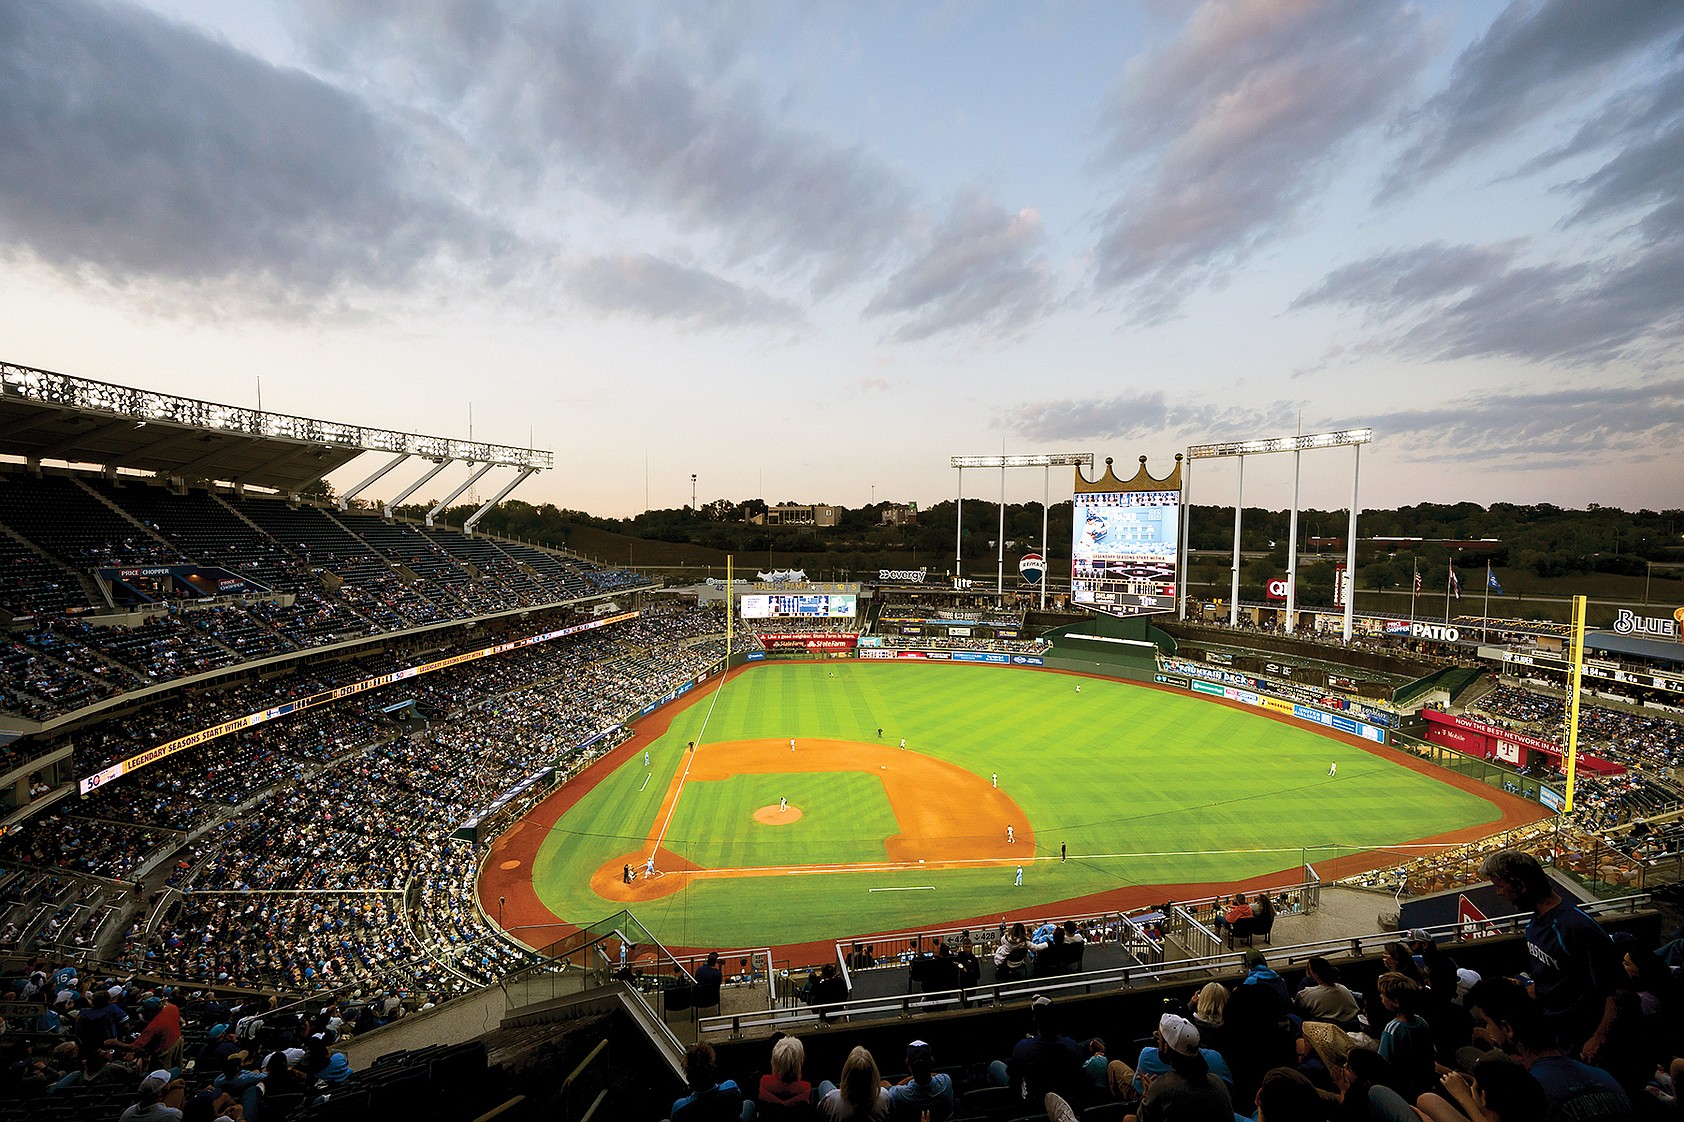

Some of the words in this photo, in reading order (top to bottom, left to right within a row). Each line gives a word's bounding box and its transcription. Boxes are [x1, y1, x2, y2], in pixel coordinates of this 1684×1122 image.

[889, 570, 926, 584] evergy
[220, 583, 245, 591] CHOPPER
[753, 583, 776, 591] HALL
[1613, 608, 1675, 636] BLUE
[1412, 623, 1459, 642] PATIO
[1180, 664, 1222, 680] FOUNTAIN
[1224, 671, 1248, 685] DECK
[1590, 667, 1599, 676] 84
[1448, 731, 1465, 740] Mobile
[1456, 718, 1472, 728] NOW
[1474, 722, 1486, 732] THE
[1487, 726, 1503, 736] BEST
[1505, 731, 1540, 747] NETWORK
[1541, 742, 1549, 750] IN
[1550, 745, 1585, 762] AMCA
[88, 775, 101, 789] 50
[128, 744, 166, 770] LEGENDARY
[168, 735, 200, 753] SEASONS
[202, 727, 223, 740] START
[225, 721, 241, 733] WITH
[242, 718, 248, 727] A
[1501, 741, 1514, 757] T
[56, 974, 68, 984] 16
[12, 1005, 30, 1015] 427
